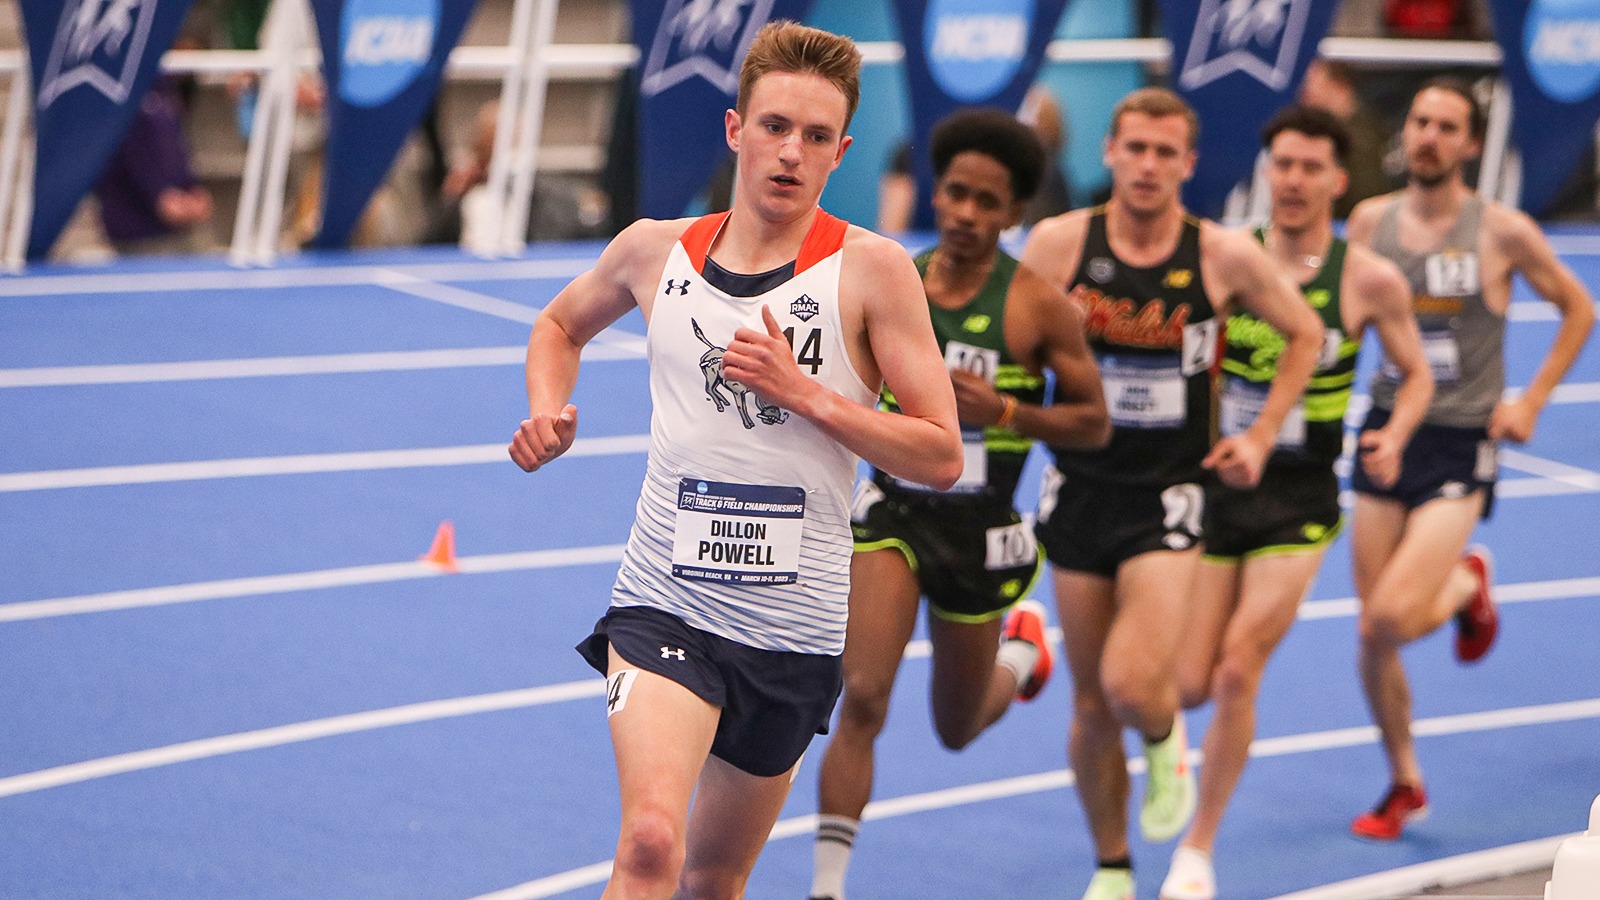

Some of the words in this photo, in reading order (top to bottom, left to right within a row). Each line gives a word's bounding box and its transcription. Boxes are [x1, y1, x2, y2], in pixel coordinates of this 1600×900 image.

[791, 303, 818, 313] RMAC
[695, 497, 717, 508] TRACK
[723, 501, 743, 510] FIELD
[744, 504, 803, 513] CHAMPIONSHIPS
[711, 520, 767, 540] DILLON
[698, 541, 775, 565] POWELL
[606, 672, 626, 712] 4
